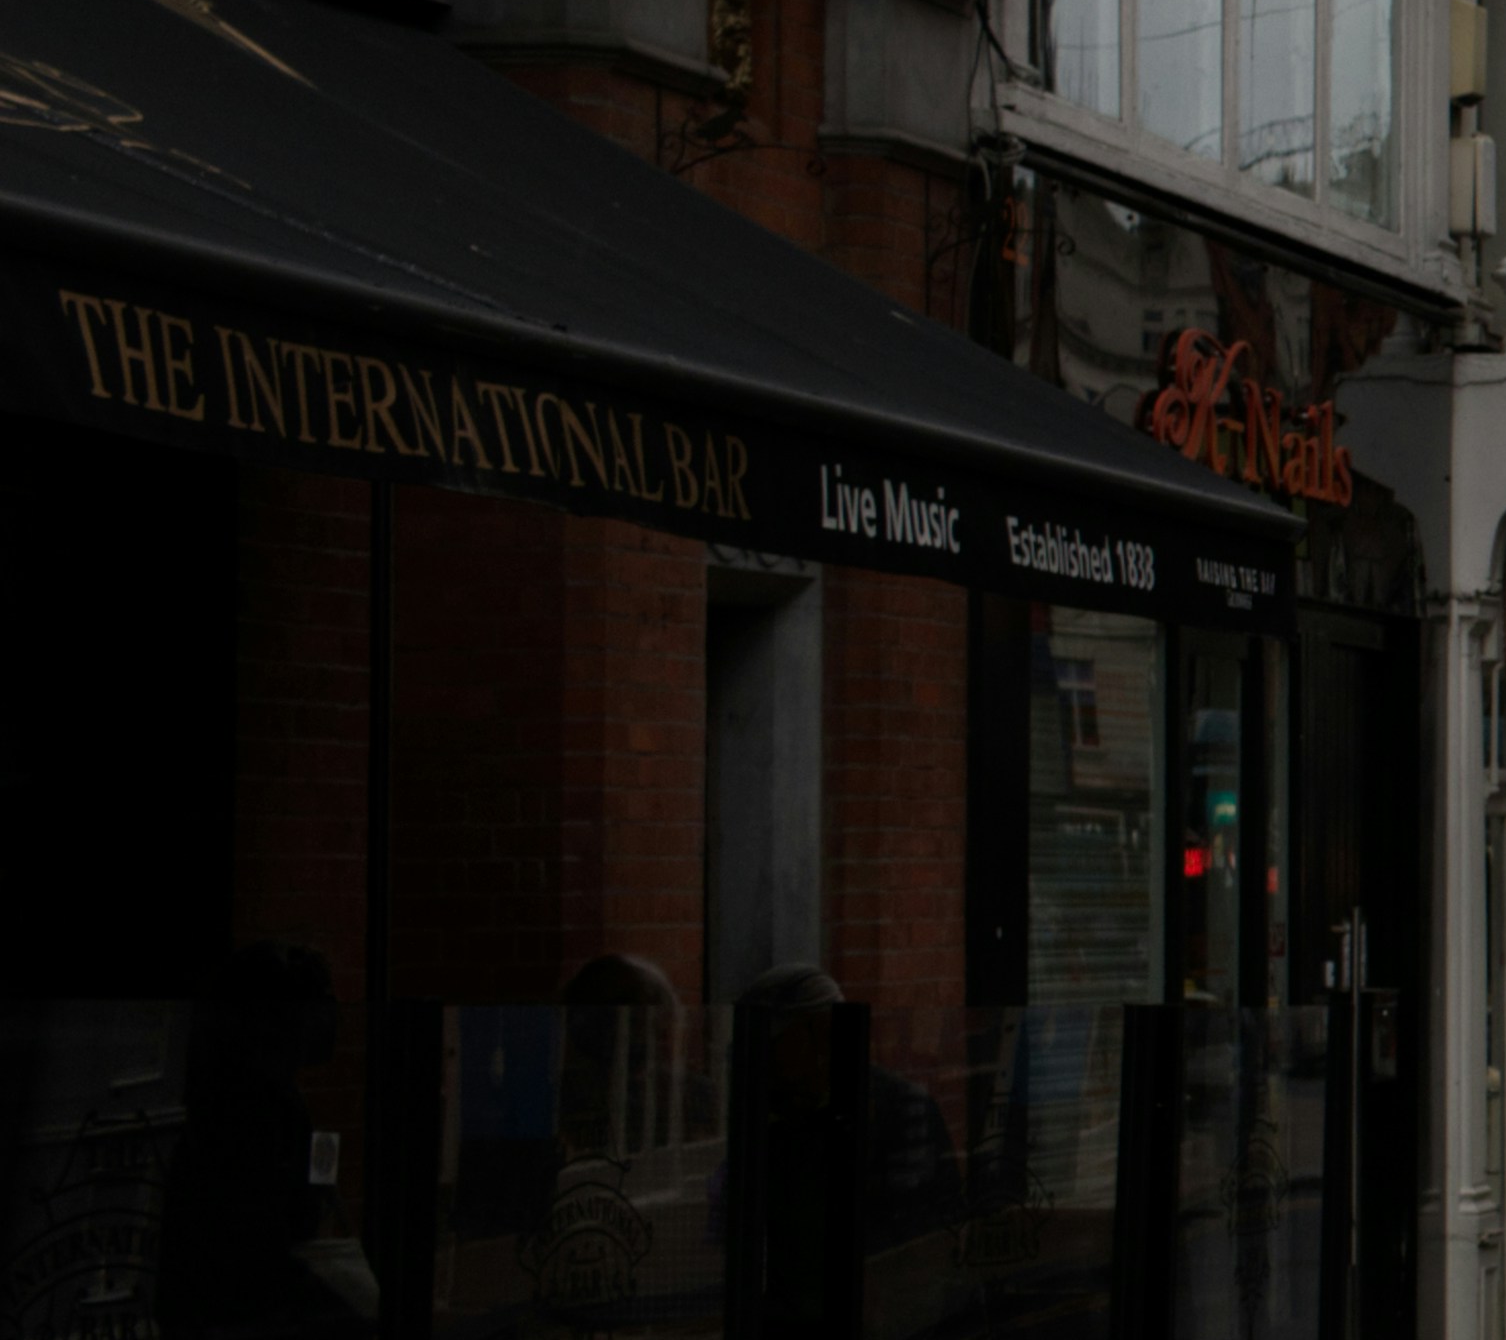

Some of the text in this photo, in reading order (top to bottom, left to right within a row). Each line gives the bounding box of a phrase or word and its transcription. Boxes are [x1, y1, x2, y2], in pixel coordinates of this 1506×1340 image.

[57, 287, 753, 522] THE INTERNATIONAL BAR
[818, 462, 878, 540] Live
[884, 474, 962, 556] Music
[1005, 514, 1116, 585] Established
